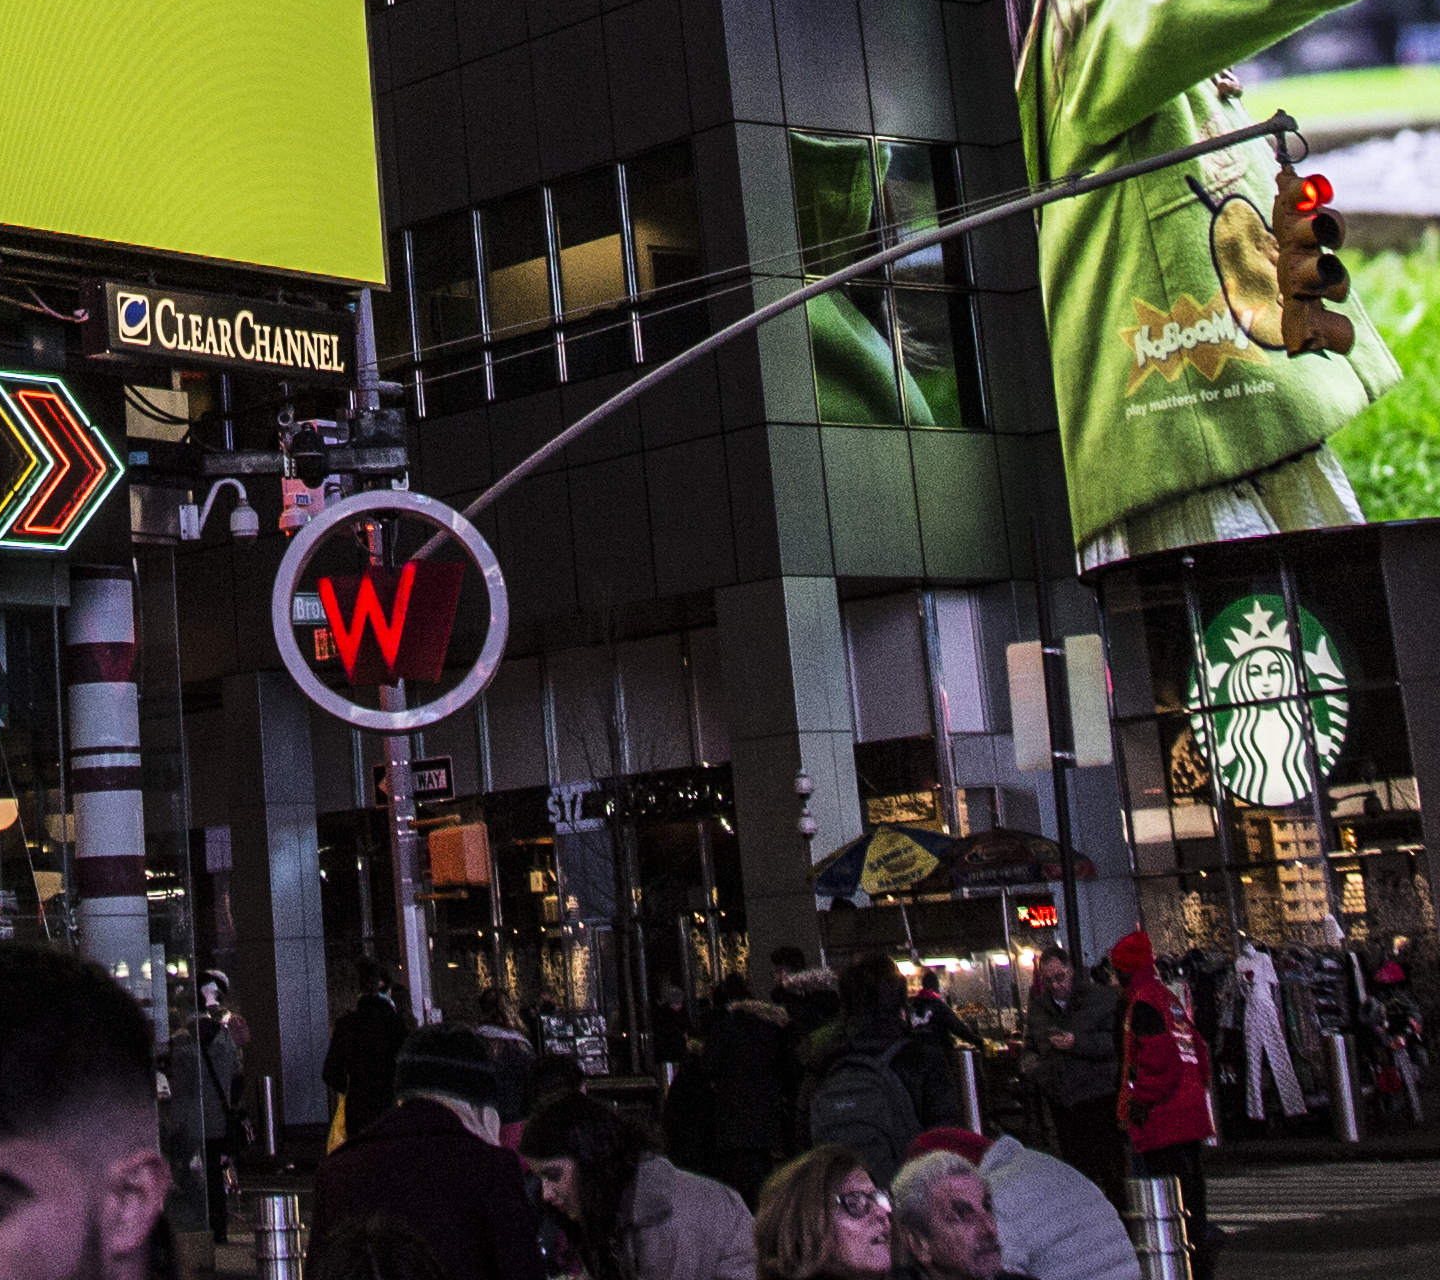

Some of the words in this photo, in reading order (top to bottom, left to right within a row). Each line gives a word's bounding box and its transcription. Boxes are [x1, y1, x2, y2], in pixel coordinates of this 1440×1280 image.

[1125, 401, 1147, 420] play
[1149, 393, 1198, 412] matters
[1200, 388, 1220, 404] for
[1223, 383, 1242, 400] all
[1245, 378, 1276, 396] kids
[318, 561, 418, 683] W
